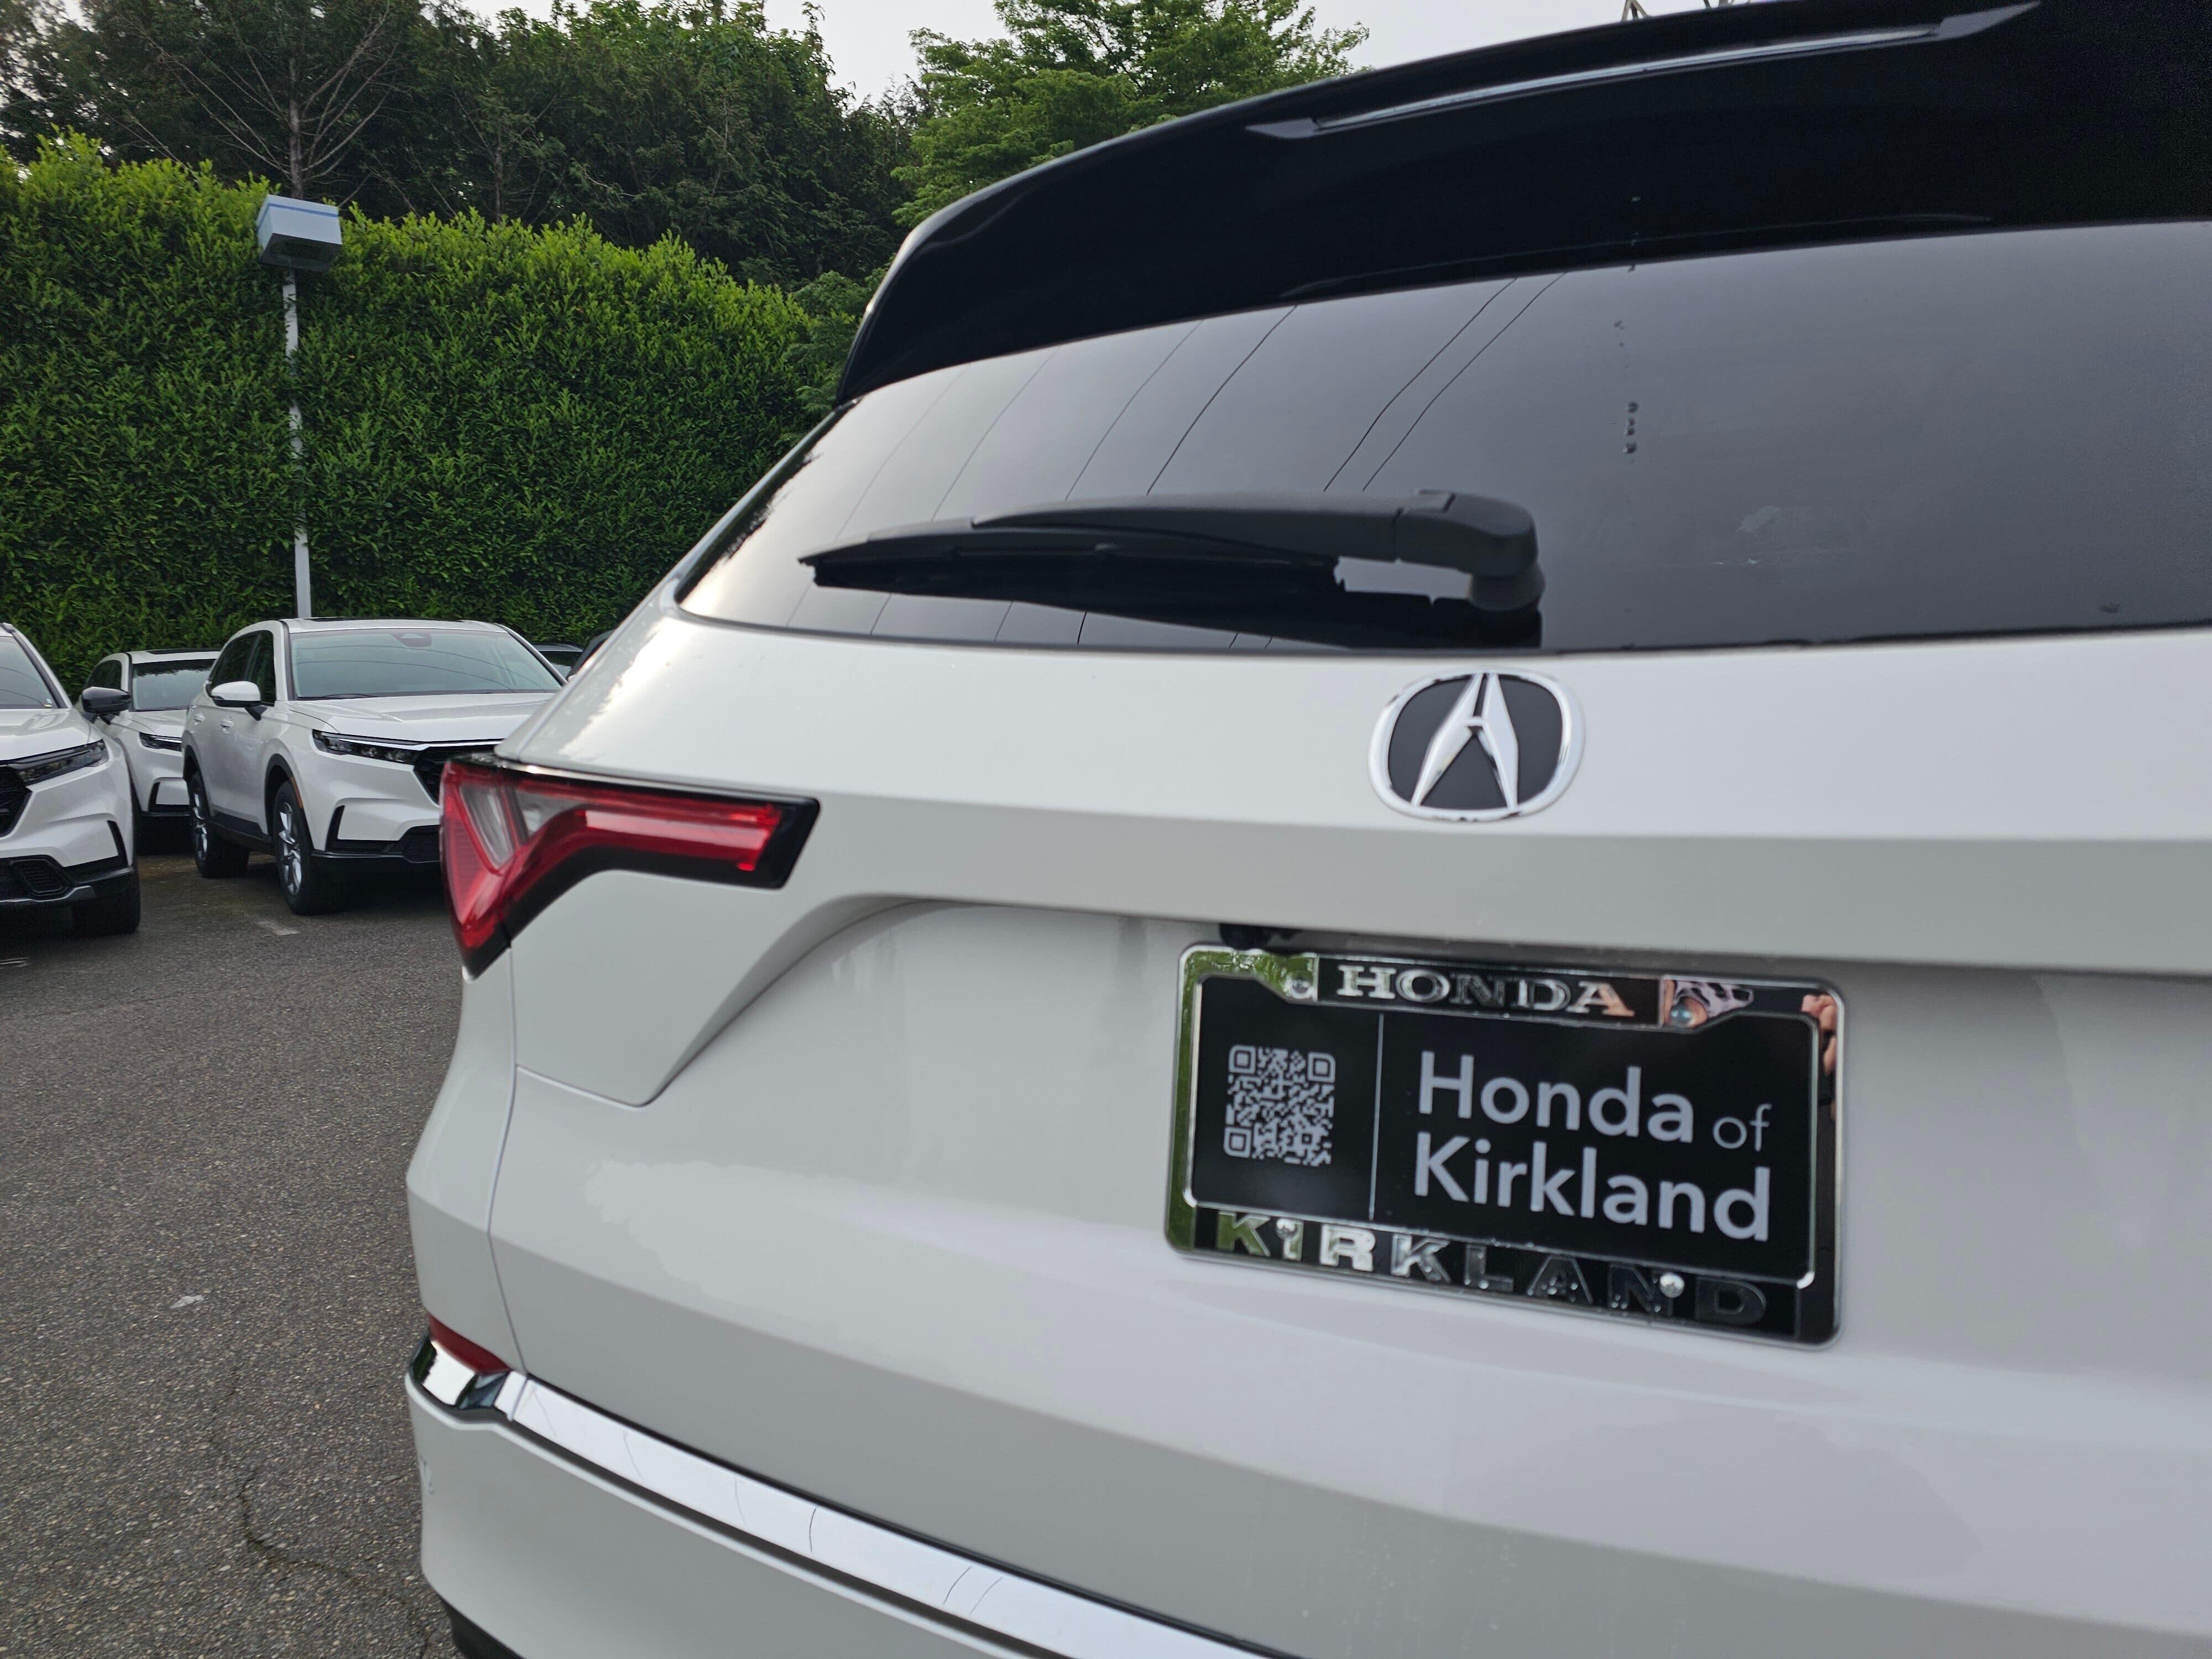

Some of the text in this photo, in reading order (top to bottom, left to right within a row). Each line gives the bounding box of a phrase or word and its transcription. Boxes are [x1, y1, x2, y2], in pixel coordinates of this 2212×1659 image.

[1337, 966, 1634, 1016] HONDA
[1418, 1051, 1772, 1151] Honda of
[1413, 1131, 1770, 1242] Kirkland
[1217, 1211, 1767, 1324] KIRKLAND
